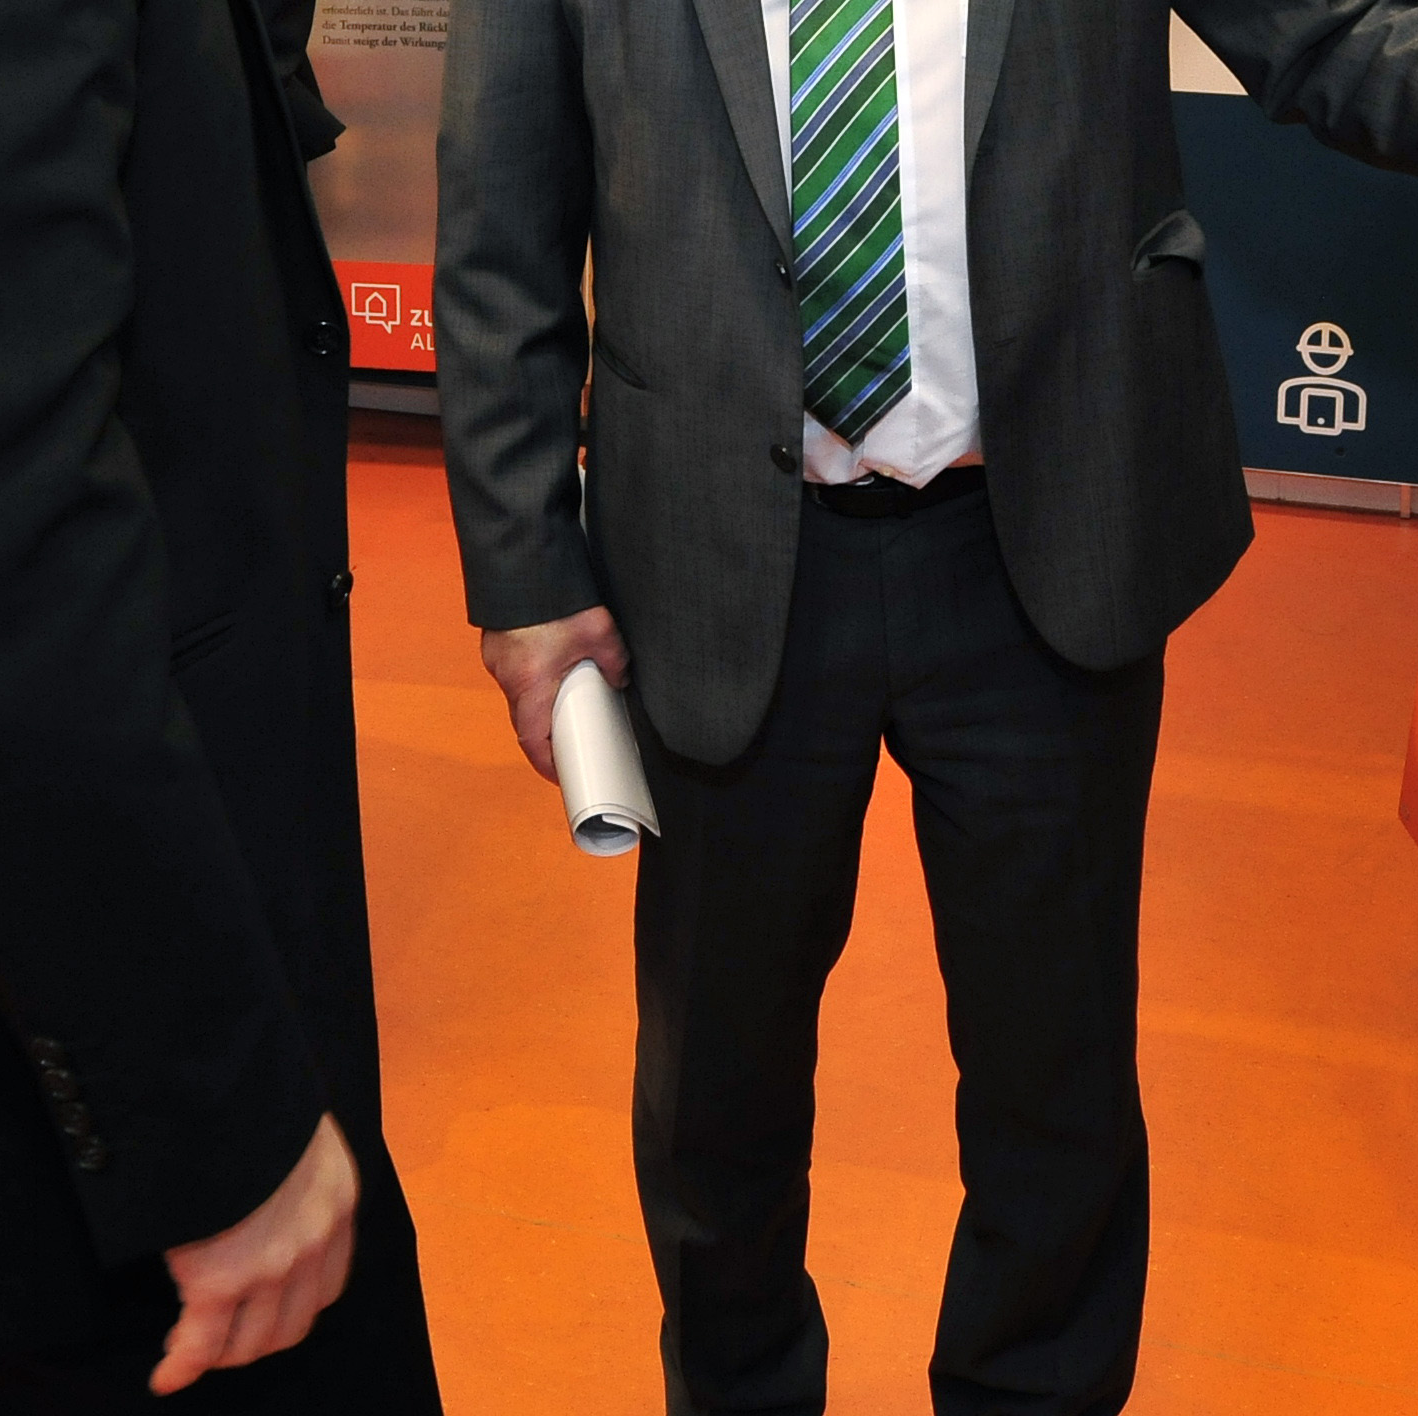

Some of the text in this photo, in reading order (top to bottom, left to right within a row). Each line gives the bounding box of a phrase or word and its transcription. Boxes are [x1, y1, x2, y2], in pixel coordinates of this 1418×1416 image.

[391, 6, 409, 17] Das
[339, 20, 397, 33] Temperatur
[399, 21, 416, 32] des
[418, 21, 448, 33] Rückl
[353, 36, 380, 48] steigt
[382, 36, 397, 46] der
